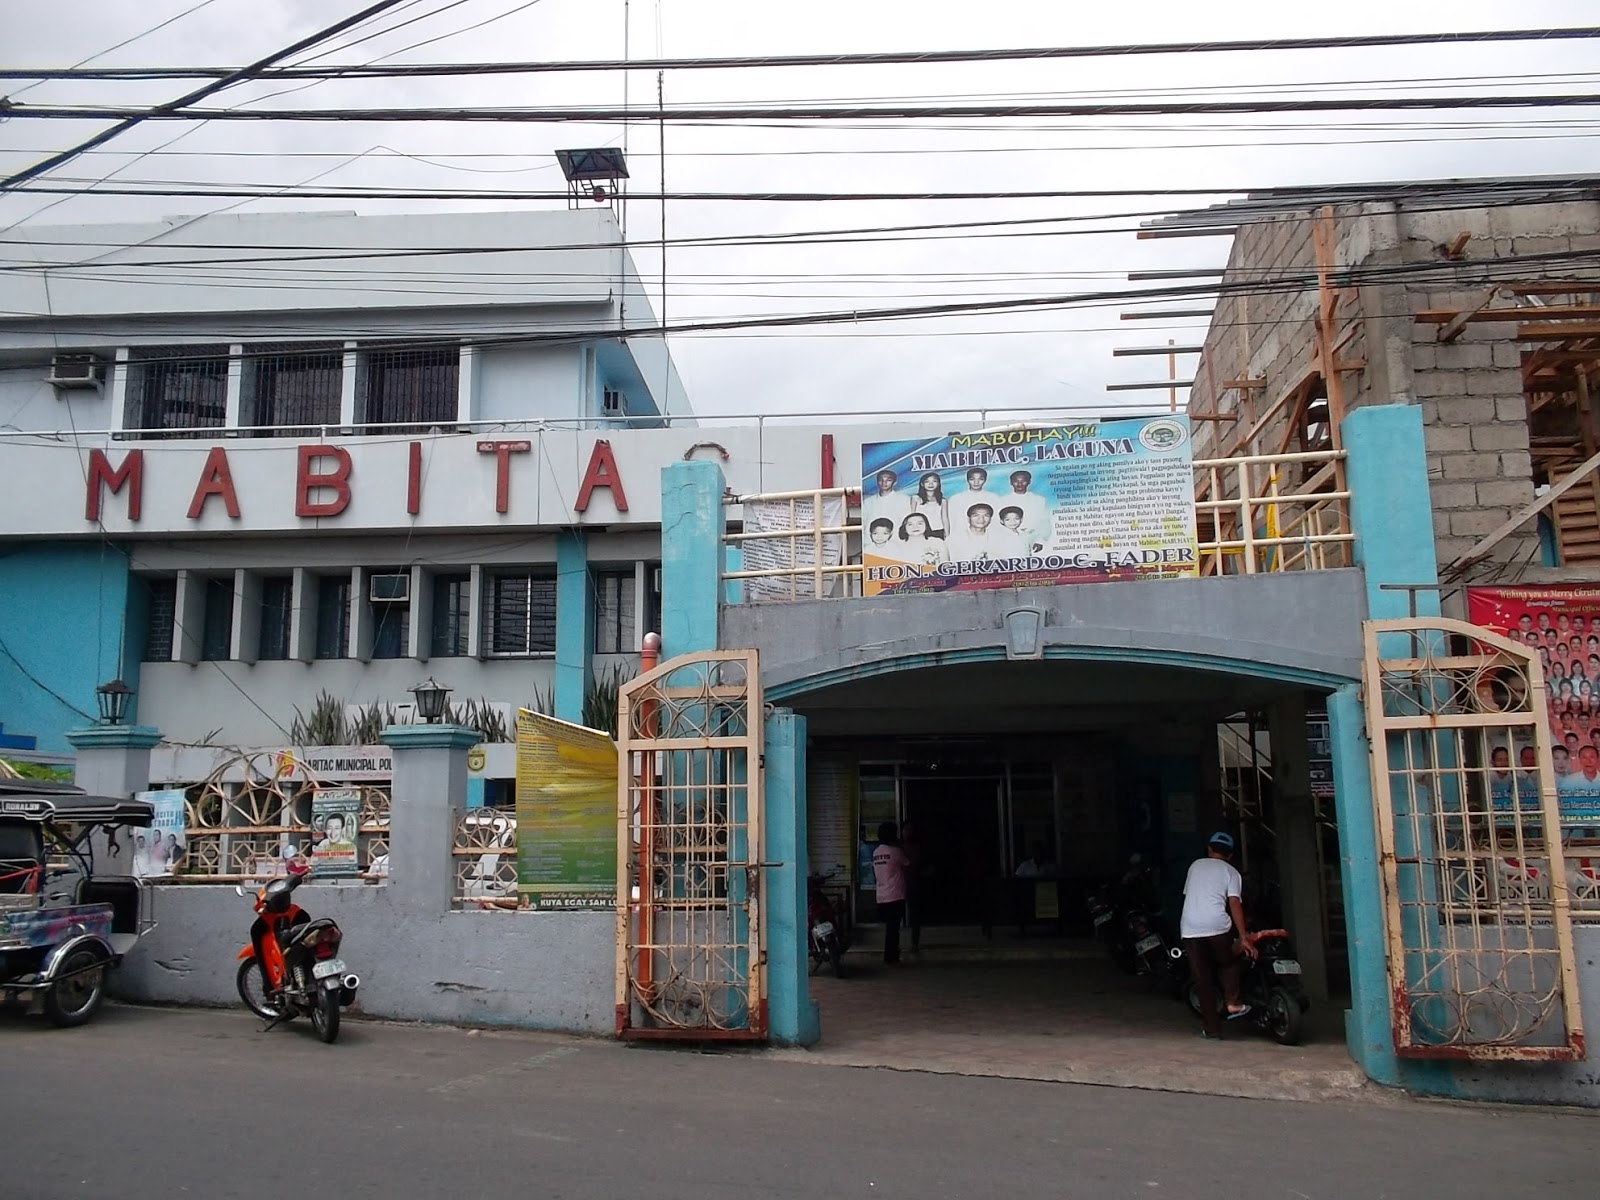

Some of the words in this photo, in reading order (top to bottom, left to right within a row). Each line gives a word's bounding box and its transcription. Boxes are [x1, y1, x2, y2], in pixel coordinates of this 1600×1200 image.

[951, 425, 1096, 448] MABUHAY!!!
[911, 446, 1030, 471] MABITAC,
[1034, 438, 1135, 461] LAGUNA
[867, 564, 929, 580] HON.
[937, 555, 1064, 576] GERARDO
[1073, 553, 1096, 568] C.
[1104, 548, 1195, 566] FADER
[1549, 590, 1573, 599] Merry
[299, 758, 333, 771] ABITAC
[335, 758, 376, 770] MUNICIPAL
